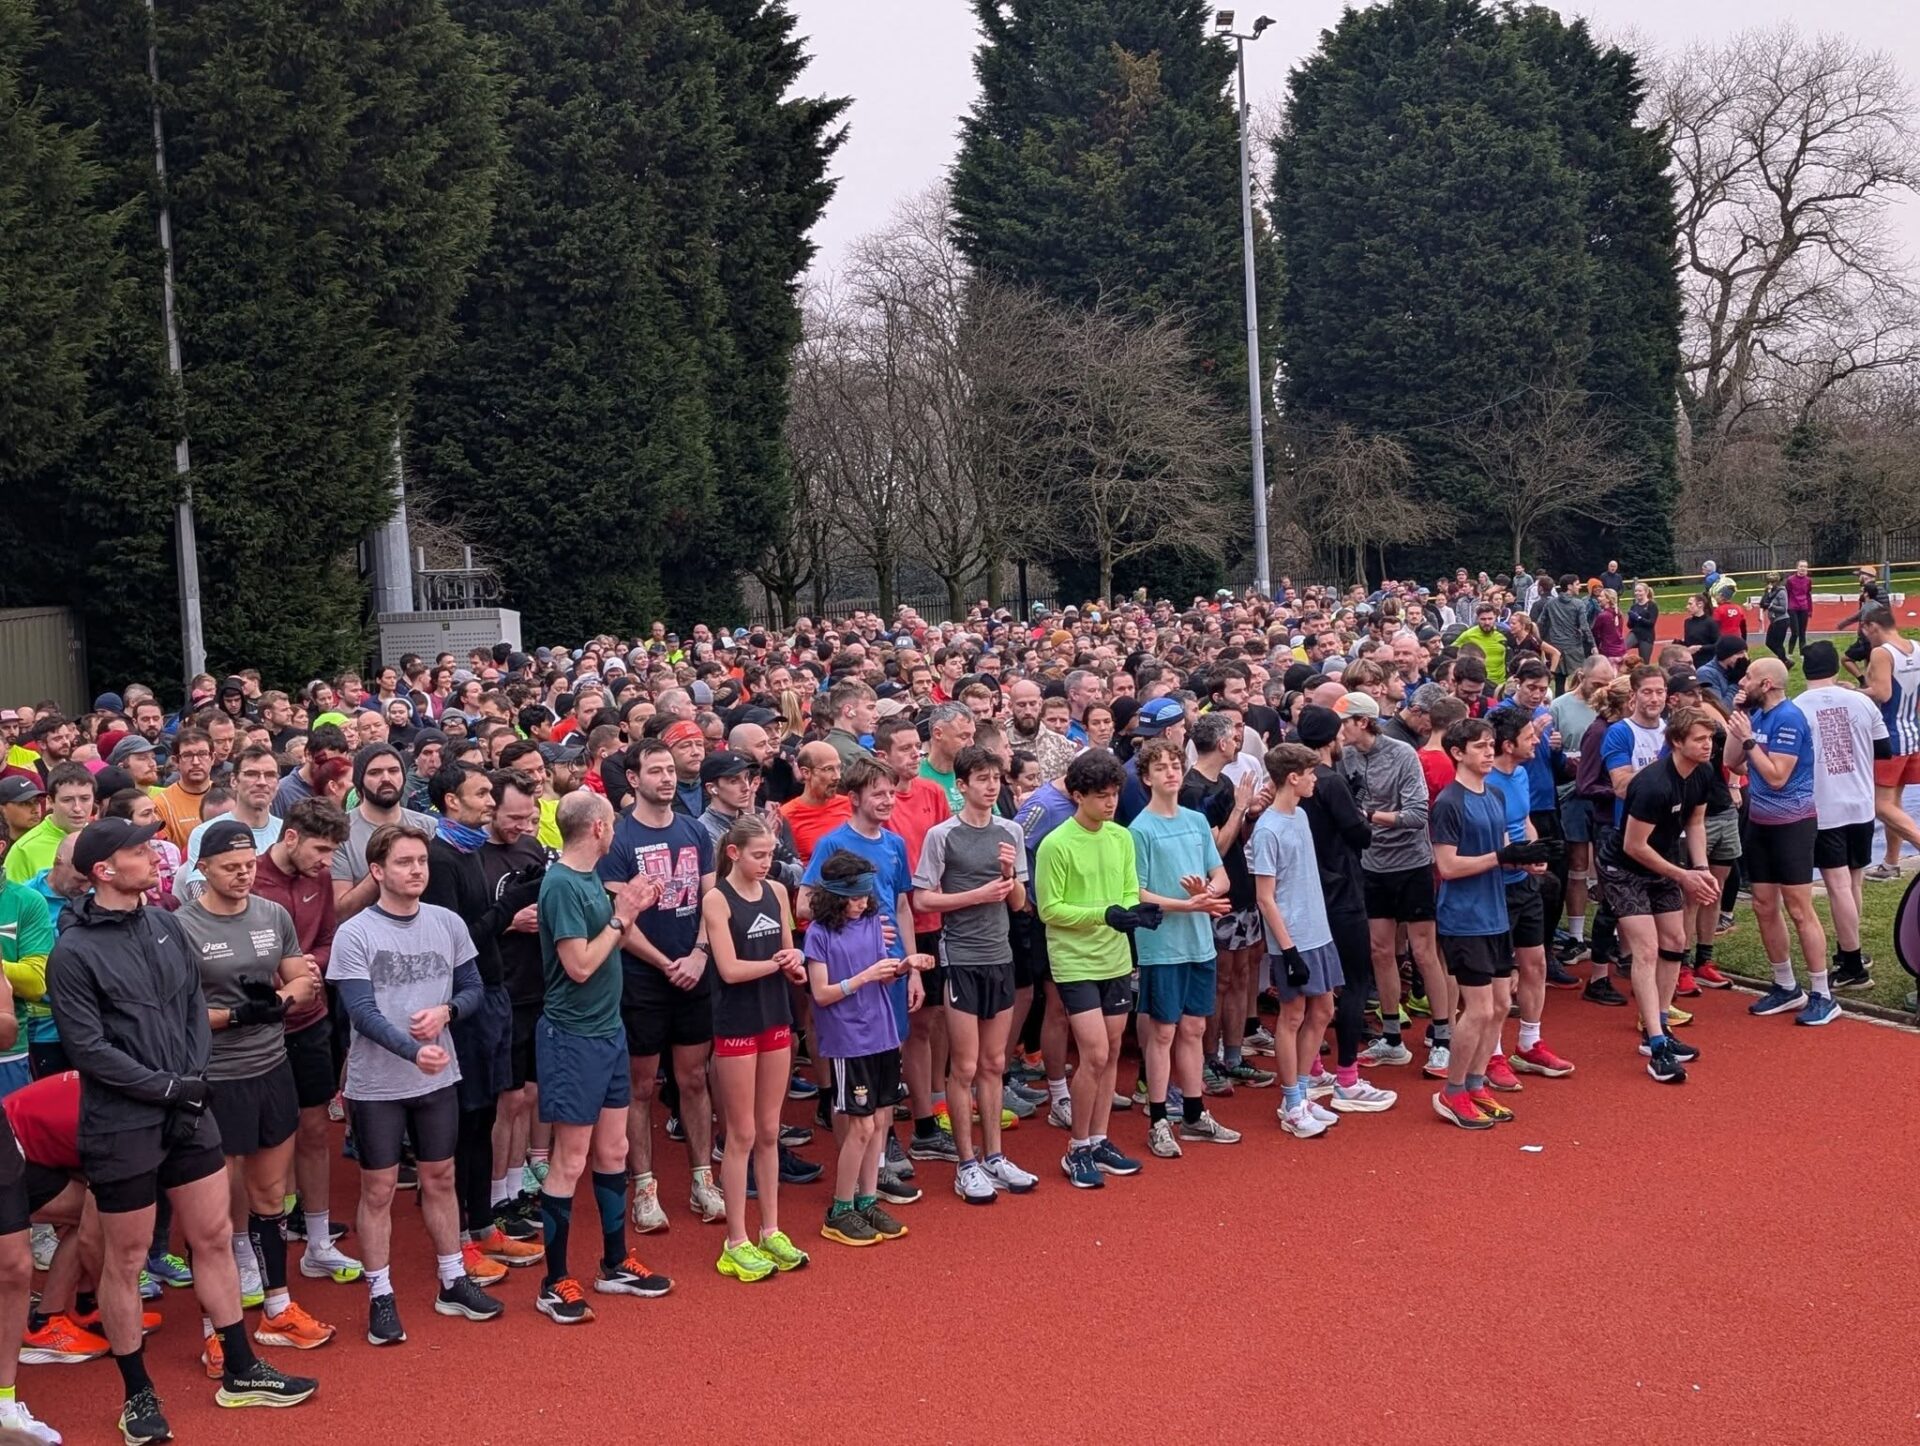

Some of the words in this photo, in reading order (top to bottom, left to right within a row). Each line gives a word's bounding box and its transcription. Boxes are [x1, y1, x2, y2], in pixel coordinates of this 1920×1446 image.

[1816, 707, 1848, 718] ANCOATS
[1827, 764, 1856, 776] MARINA
[724, 1037, 756, 1048] NIKE
[233, 1379, 251, 1388] new
[251, 1379, 286, 1390] balance
